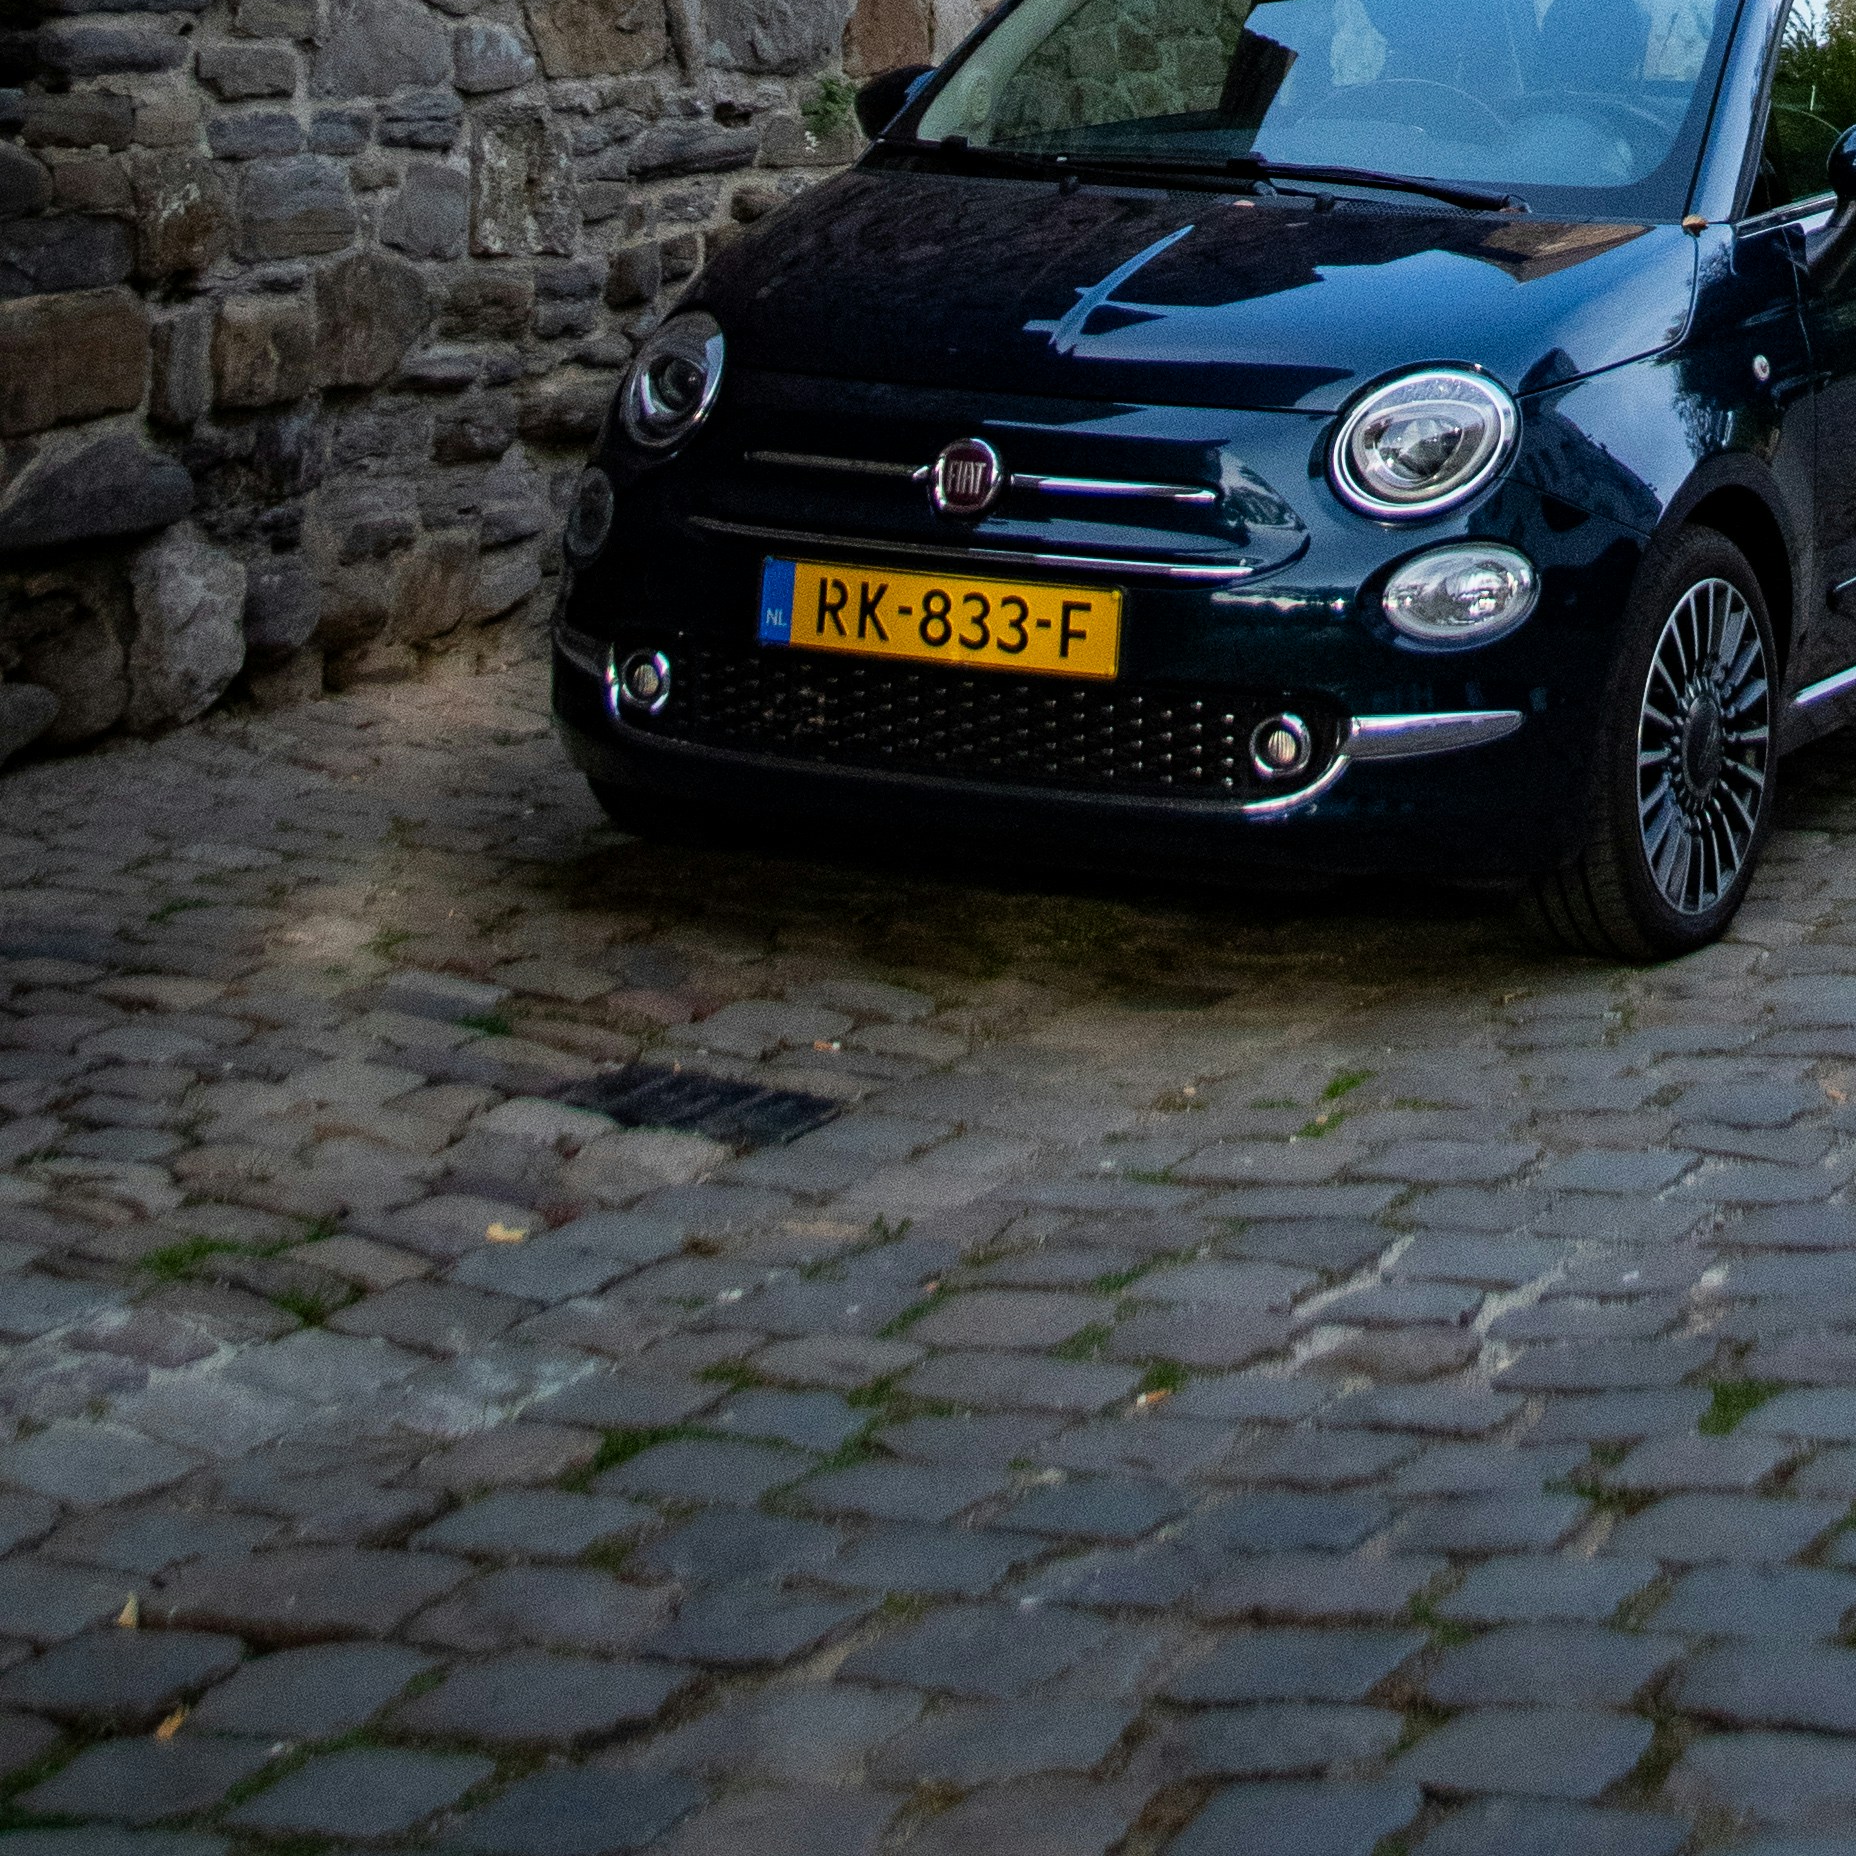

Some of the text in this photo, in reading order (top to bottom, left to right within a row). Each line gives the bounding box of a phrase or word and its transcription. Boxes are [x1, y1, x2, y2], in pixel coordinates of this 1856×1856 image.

[949, 460, 987, 494] FIAT
[765, 607, 787, 627] NL
[816, 575, 1092, 658] RK-833-F
